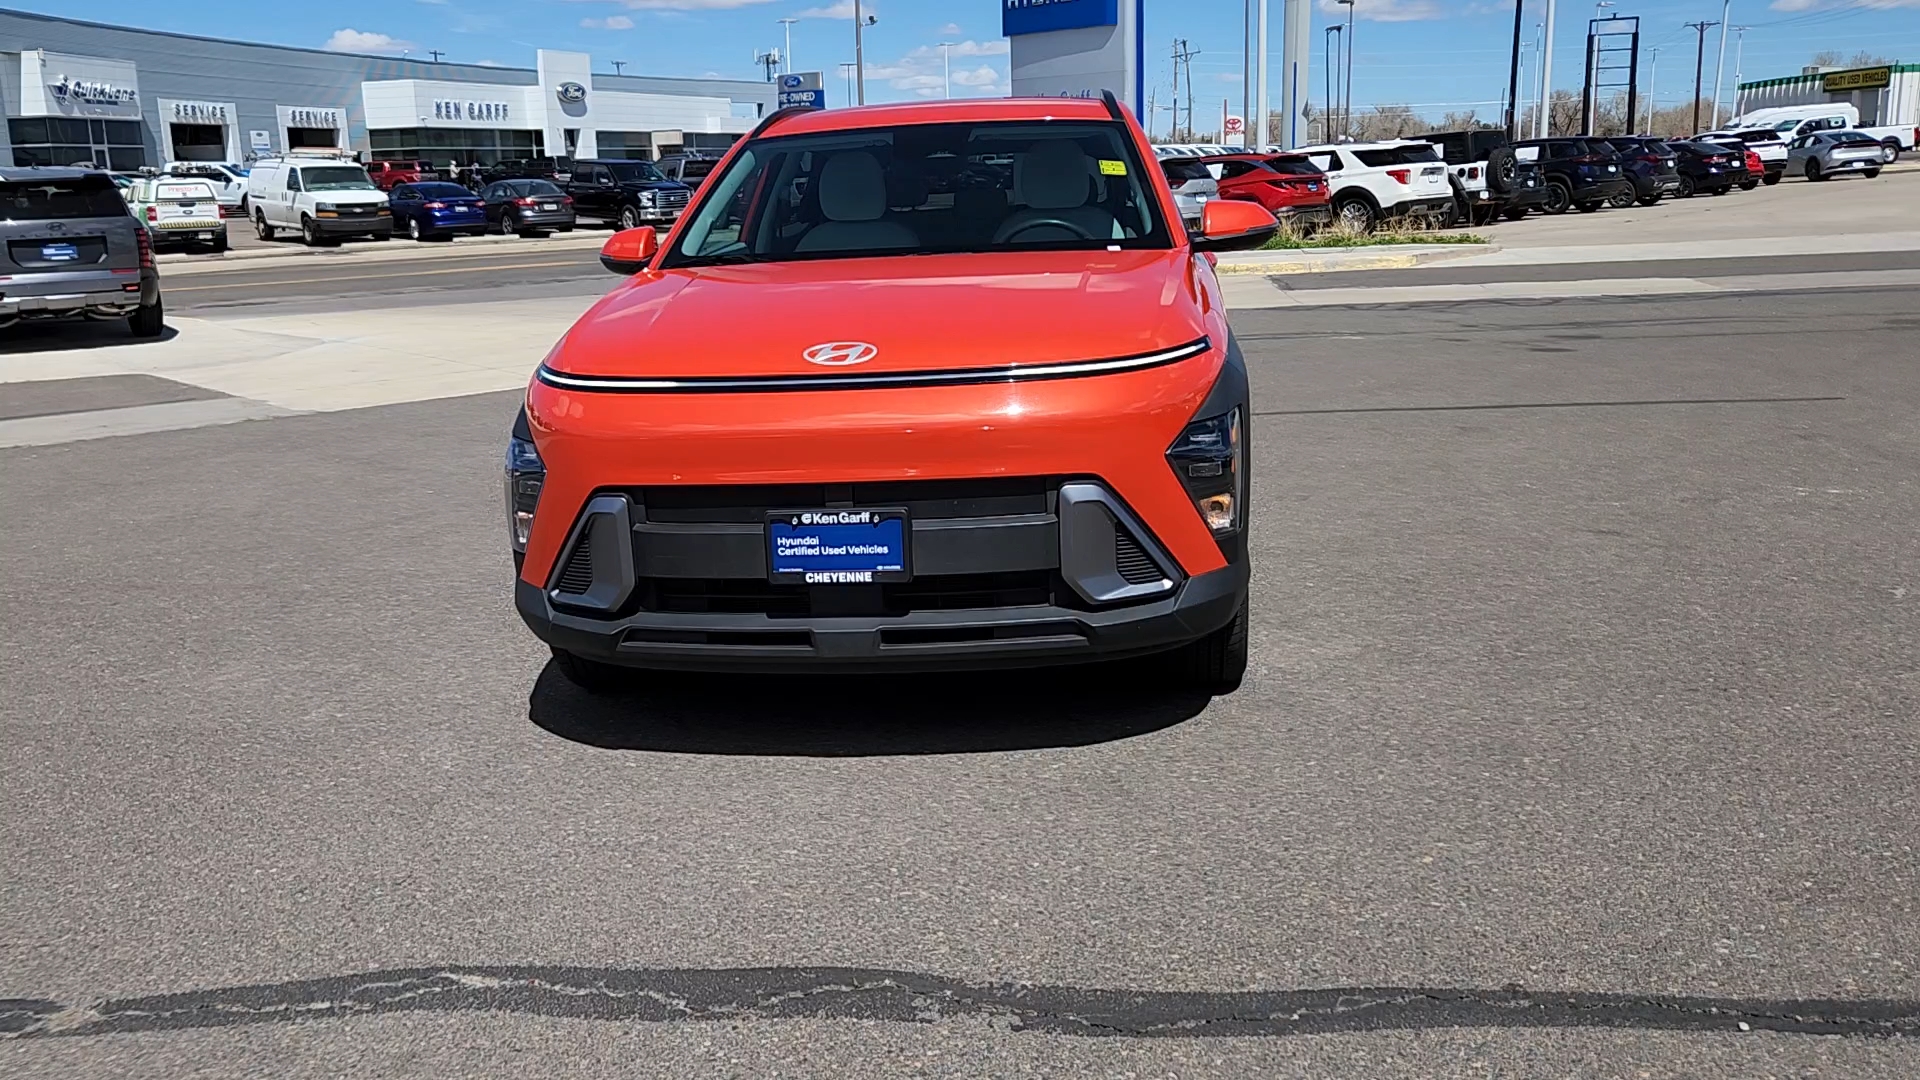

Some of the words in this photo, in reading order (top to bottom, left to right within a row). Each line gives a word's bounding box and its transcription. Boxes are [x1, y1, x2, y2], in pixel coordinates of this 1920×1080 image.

[1825, 75, 1846, 87] QUALITY
[1847, 73, 1860, 84] USED
[1862, 71, 1888, 83] VEHICLES
[174, 103, 226, 117] SERVICE
[435, 101, 461, 114] KEN
[468, 102, 508, 116] GARFF
[290, 110, 337, 122] SERVICE
[813, 513, 838, 524] Ken
[839, 512, 870, 524] Garff
[777, 536, 819, 547] Hyundai
[777, 547, 819, 556] Certified
[821, 546, 847, 555] Used
[849, 544, 889, 554] Vehicles
[805, 572, 872, 583] CHEYENNE
